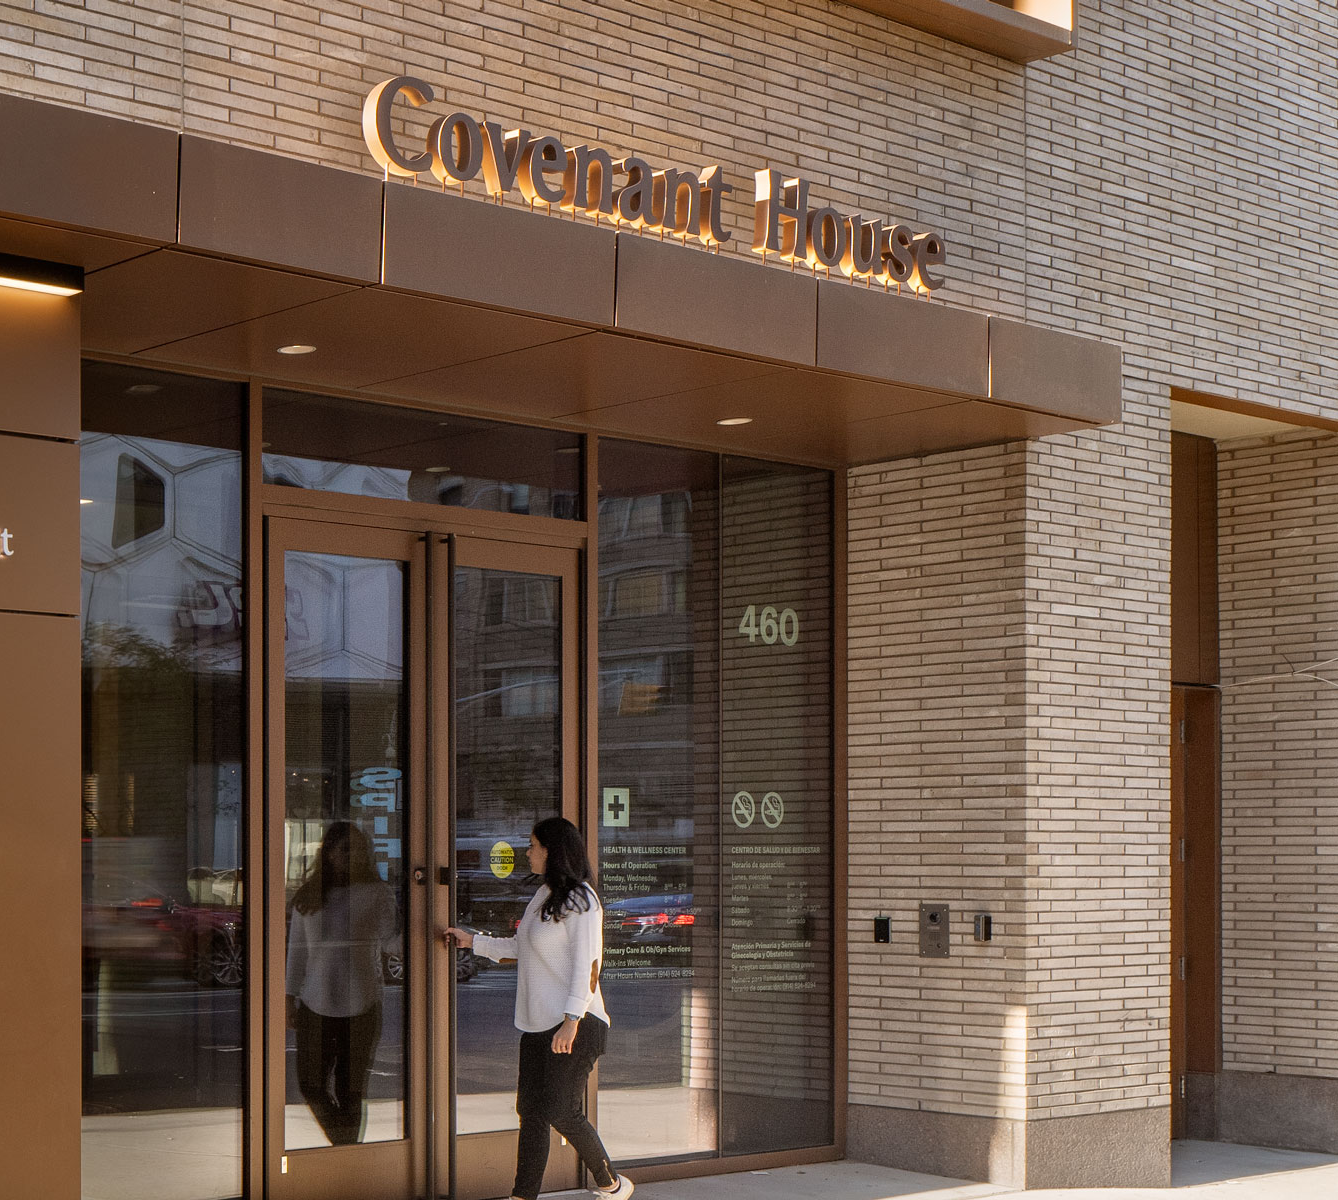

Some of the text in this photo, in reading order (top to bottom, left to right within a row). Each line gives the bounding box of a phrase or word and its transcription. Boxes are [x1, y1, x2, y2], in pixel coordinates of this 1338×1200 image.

[363, 76, 947, 292] Covenant House
[739, 605, 799, 647] 460
[603, 846, 687, 854] HEALTH & WELLNESS CENTER
[732, 846, 753, 854] CENTRO
[754, 846, 761, 854] DE
[762, 846, 780, 854] SALUD
[785, 846, 792, 854] DE
[793, 846, 820, 854] BIENESTAR
[603, 861, 658, 870] Hours of Operation:
[731, 861, 751, 869] Horario
[752, 861, 759, 869] de
[603, 874, 658, 883] Monday, Wednesday,
[603, 883, 628, 892] Thursday
[628, 883, 633, 891] &
[634, 883, 651, 892] Friday
[731, 919, 753, 927] Domingo
[781, 941, 804, 949] Servicios
[603, 945, 691, 955] Primary Care & Ob/Gyn Services
[603, 959, 652, 968] Walk-ins Welcome
[617, 972, 634, 980] Hours
[634, 971, 657, 979] Number:
